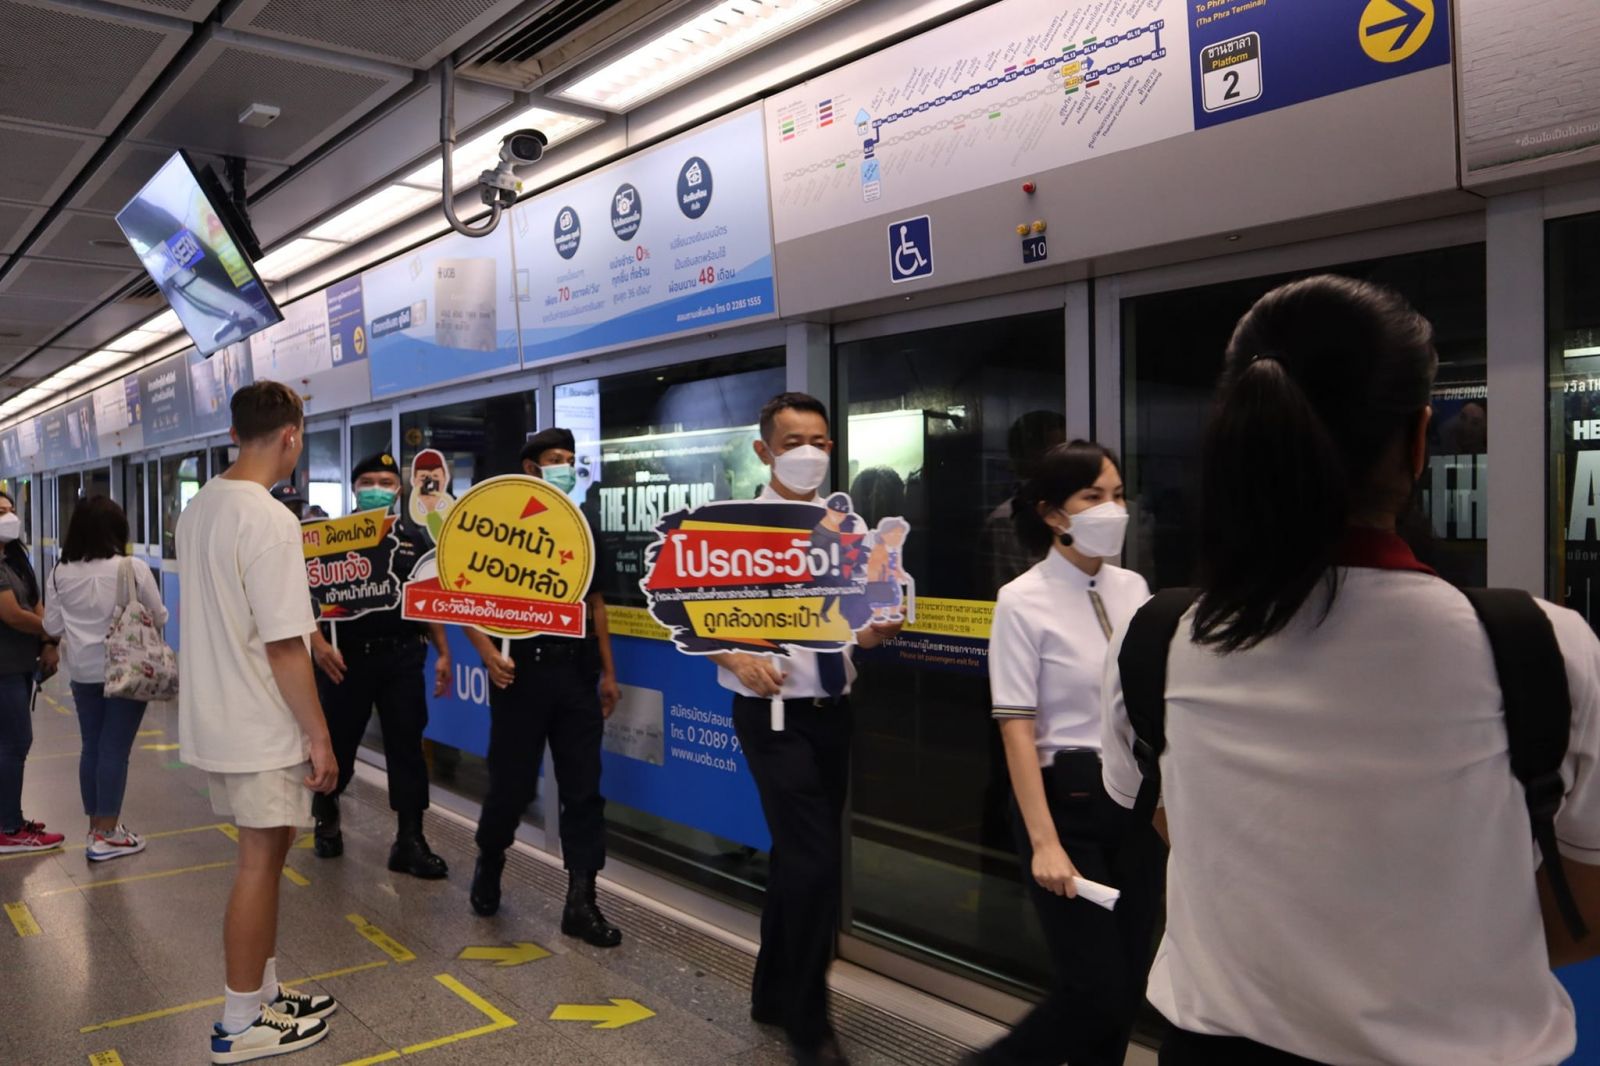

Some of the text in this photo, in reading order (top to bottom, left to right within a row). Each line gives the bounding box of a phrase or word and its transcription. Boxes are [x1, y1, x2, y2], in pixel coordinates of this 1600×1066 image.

[1196, 5, 1205, 13] To
[1196, 0, 1266, 28] (Tha Phra Terminal)
[1208, 36, 1250, 58] ชานชาลา
[1212, 52, 1248, 69] Platform
[1223, 70, 1240, 100] 2
[1031, 242, 1045, 258] 10
[698, 266, 715, 285] 48
[558, 287, 570, 302] 70
[600, 487, 626, 532] THE
[627, 484, 667, 532] LAST
[325, 518, 377, 545] ผิดปกติ
[457, 511, 555, 559] มองหน้า
[671, 533, 840, 578] โปรดระวัง!
[307, 551, 372, 588] รีบแจ้ง
[468, 551, 568, 598] มองหลัง
[325, 578, 391, 604] เจ้าหน้าที่ทันที
[432, 598, 553, 624] (ระวังมือดีแอบถ่าย)
[704, 605, 820, 634] ถูกล้วงกระเป๋า
[456, 663, 490, 707] UO
[687, 726, 695, 742] 0
[698, 728, 728, 750] 2089
[731, 735, 743, 754] 9
[671, 745, 736, 772] www.uob.co.th
